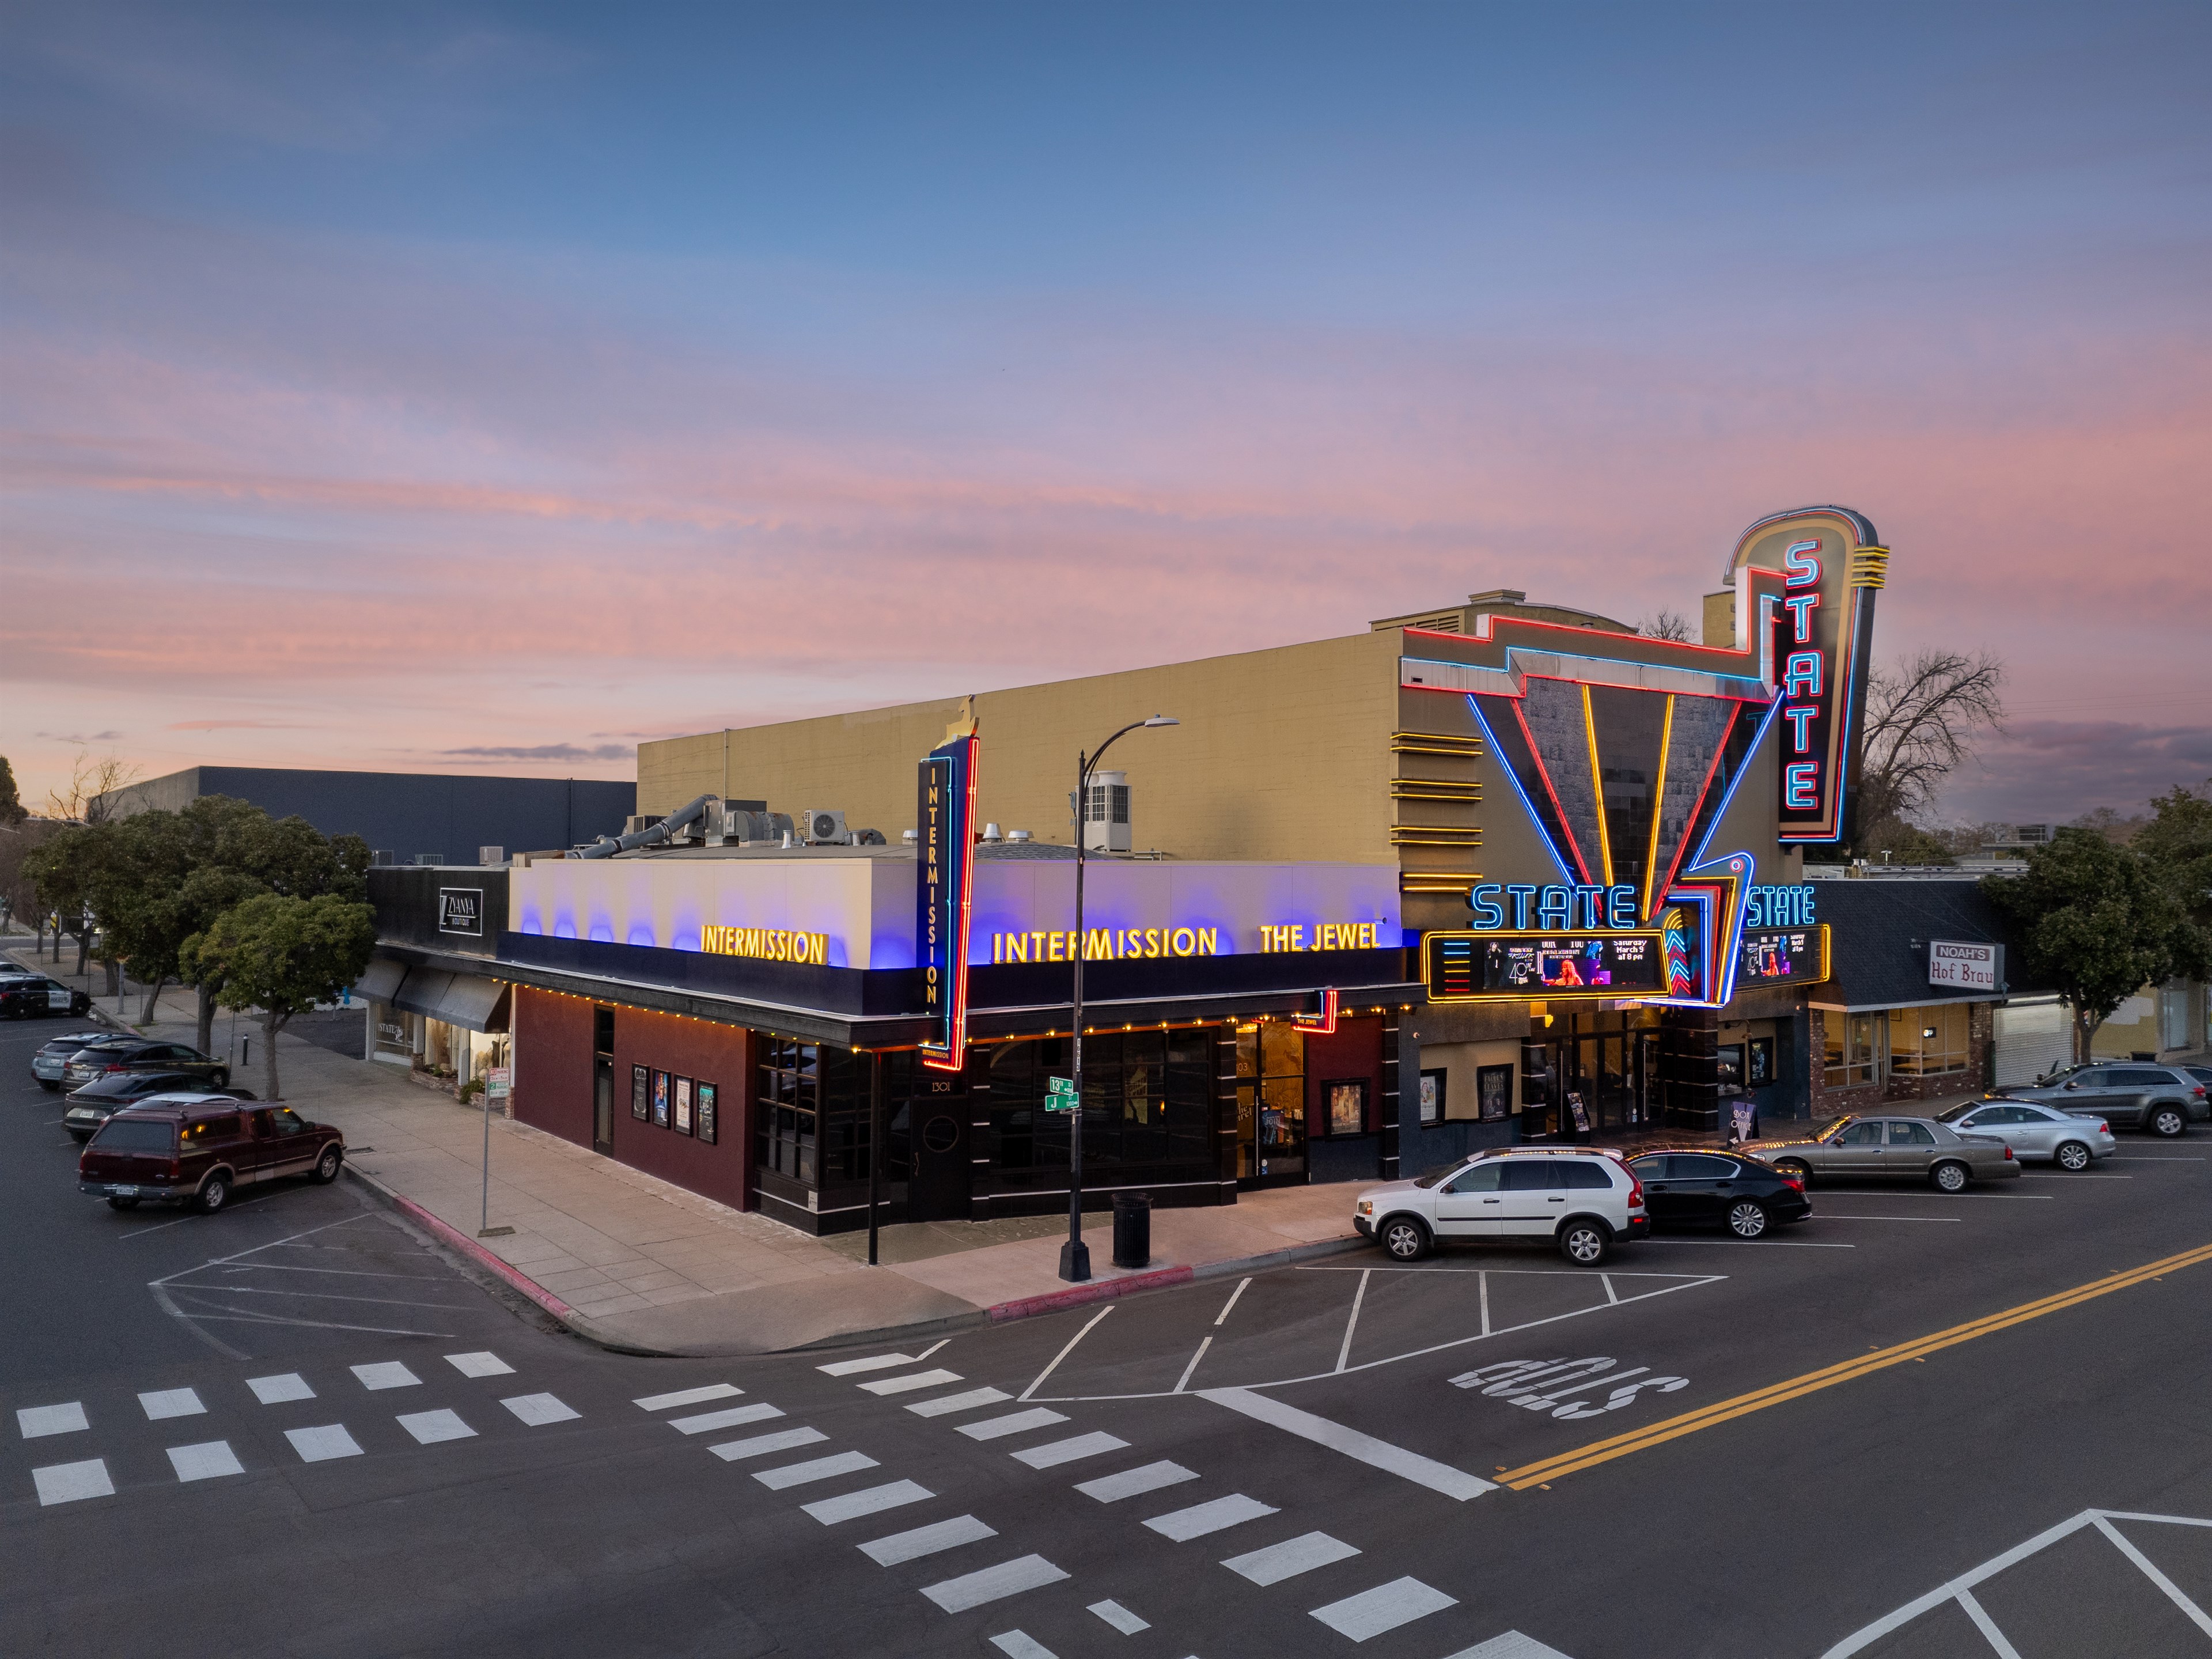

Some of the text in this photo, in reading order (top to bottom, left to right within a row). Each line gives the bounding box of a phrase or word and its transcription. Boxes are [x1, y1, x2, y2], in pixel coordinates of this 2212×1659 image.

[1784, 539, 1824, 809] STATE
[927, 767, 938, 1004] INTERMISSION
[449, 897, 474, 915] ZYANYA
[1472, 884, 1636, 930] STATE
[1747, 886, 1815, 927] STATE
[701, 925, 824, 965] INTERMISSION
[993, 927, 1218, 964] INTERMISSION
[1260, 923, 1381, 953] THE JEWEL
[1940, 946, 1986, 960] NOAH'S
[1931, 961, 1993, 983] Hof Brau
[923, 1050, 949, 1059] INTERMISSION
[932, 1082, 950, 1092] 1301
[1051, 1097, 1057, 1108] J
[1733, 1109, 1750, 1119] BOX
[1731, 1120, 1751, 1131] OFFICE
[1446, 1357, 1690, 1420] STOP
